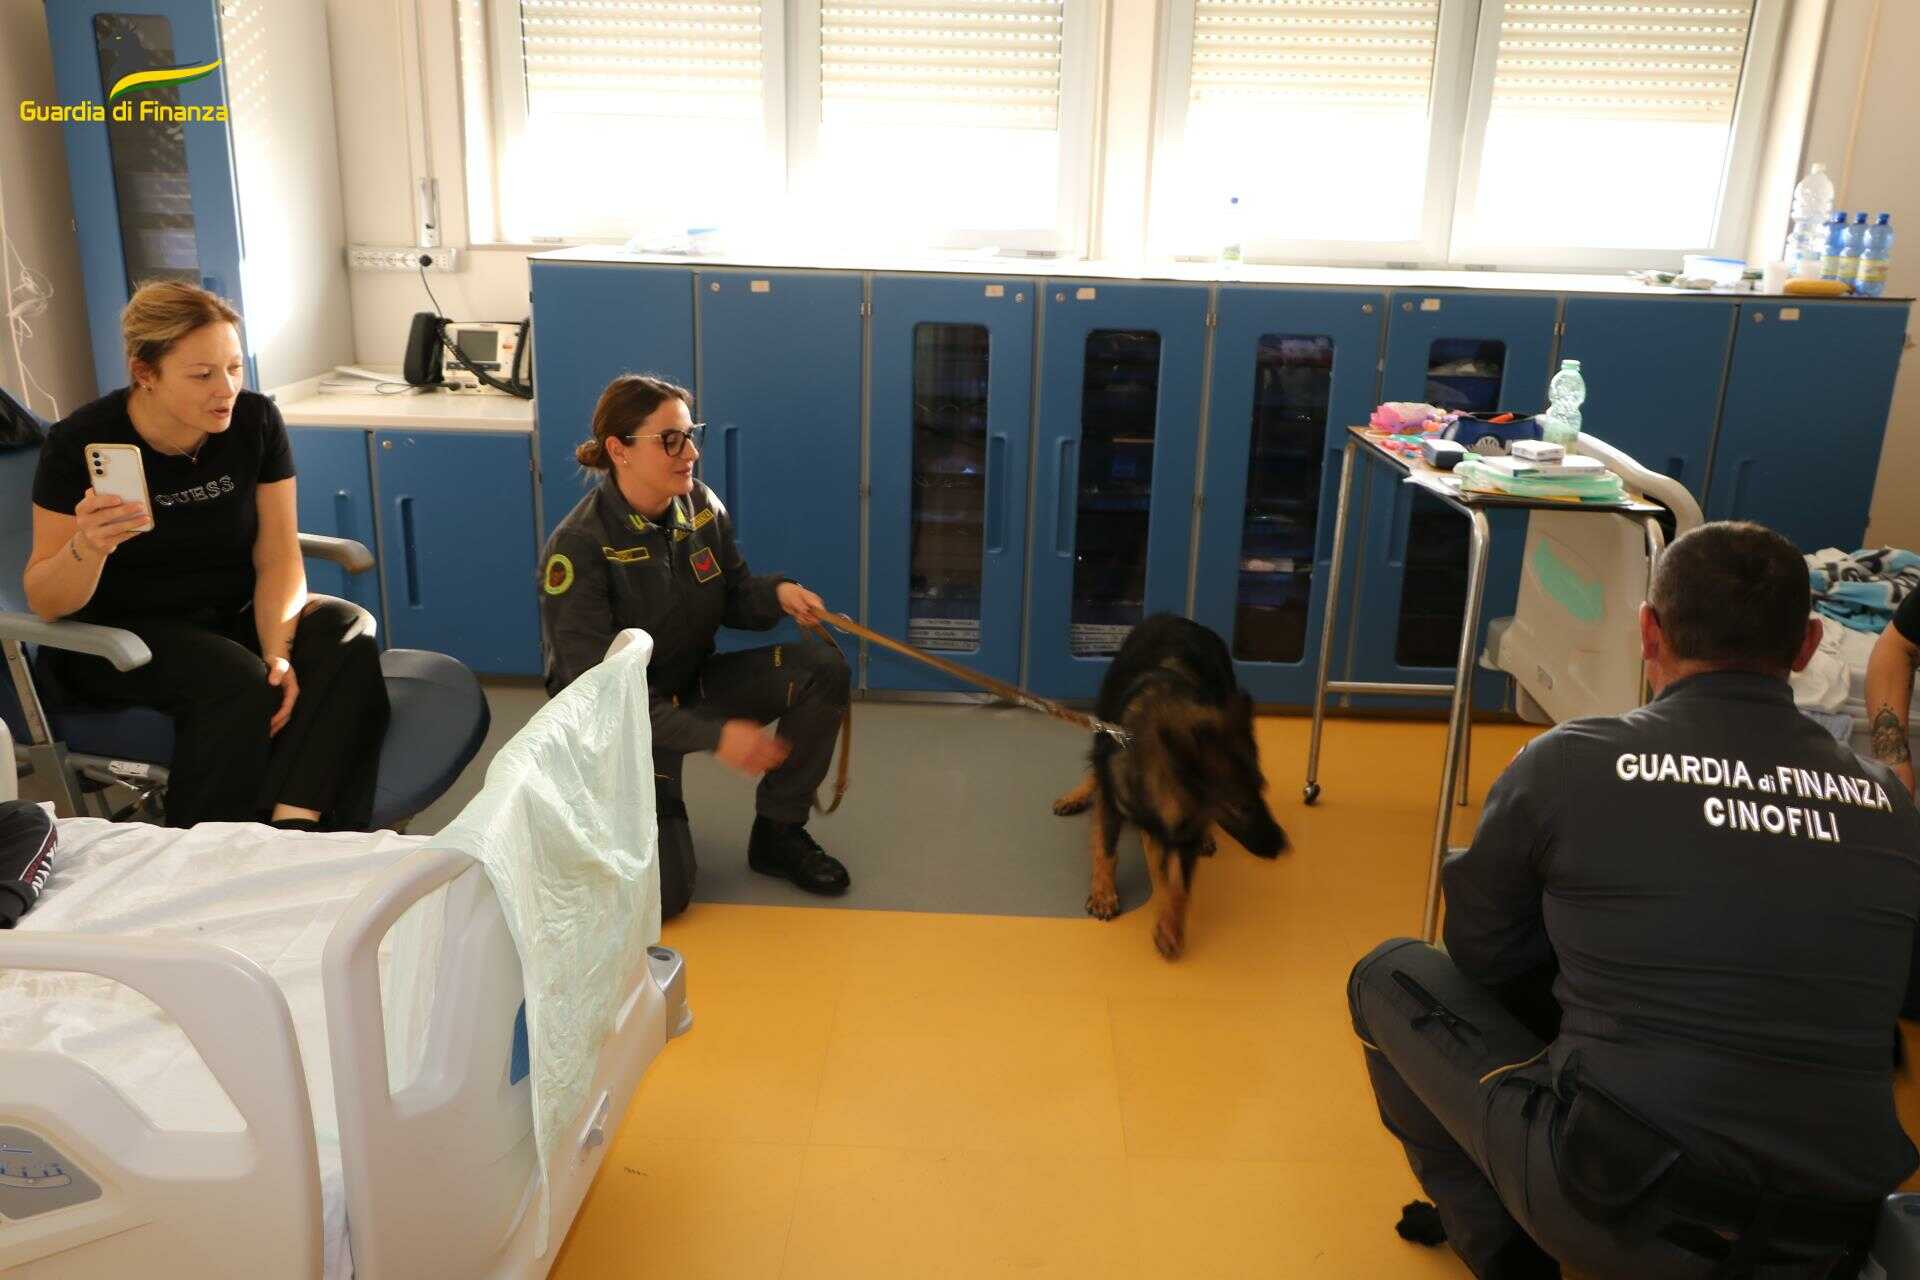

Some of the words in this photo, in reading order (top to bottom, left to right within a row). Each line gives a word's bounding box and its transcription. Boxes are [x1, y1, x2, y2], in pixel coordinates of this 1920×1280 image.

[155, 475, 235, 506] GUESS
[1616, 753, 1754, 790] GUARDIA
[1757, 774, 1777, 793] di
[1776, 766, 1893, 813] FINANZA
[1703, 797, 1841, 843] CINOFILI
